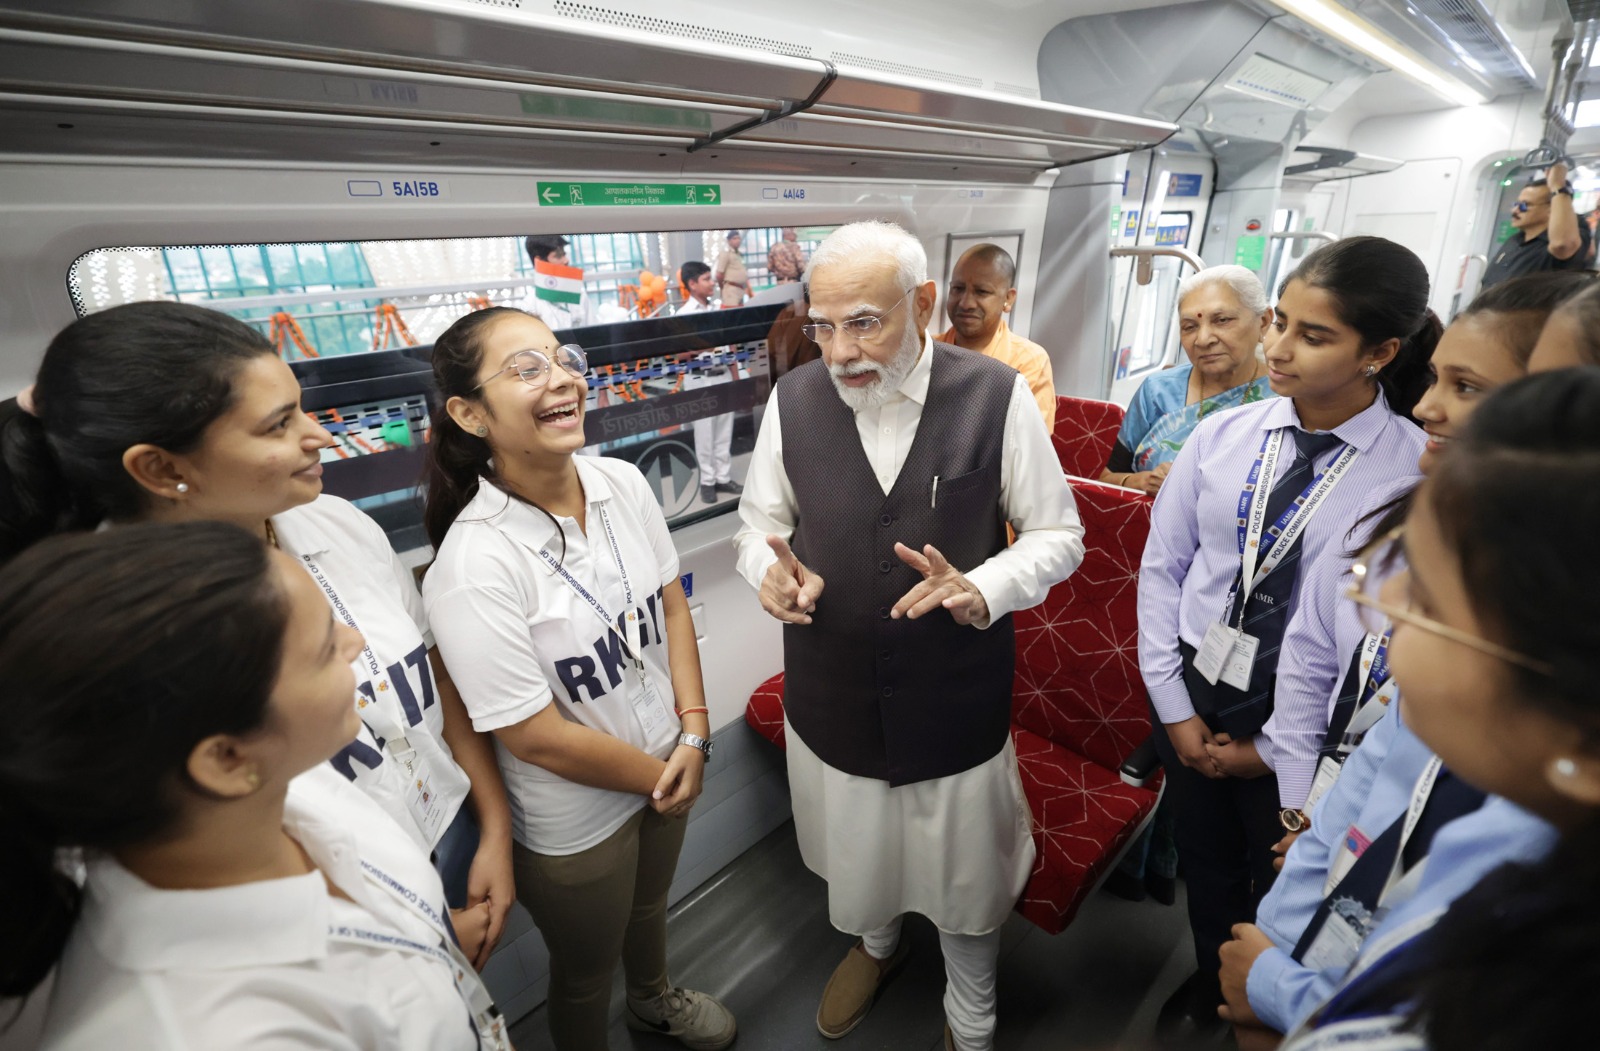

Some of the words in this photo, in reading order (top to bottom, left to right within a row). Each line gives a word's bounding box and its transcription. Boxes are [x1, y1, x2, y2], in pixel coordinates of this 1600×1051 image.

[613, 196, 647, 204] Emergency
[1270, 443, 1277, 453] OF
[1256, 452, 1275, 509] COMMISSIONERATE
[1240, 496, 1249, 513] IAMR
[1252, 509, 1264, 534] POLICE
[1271, 537, 1290, 560] POLICE
[1286, 481, 1330, 537] COMMISSIONERATE
[1326, 473, 1336, 483] OF
[1280, 509, 1297, 526] IAMR
[539, 549, 550, 559] OF
[308, 562, 320, 574] OF
[622, 580, 633, 604] POLICE
[595, 603, 613, 623] POLICE
[363, 645, 381, 676] POLICE
